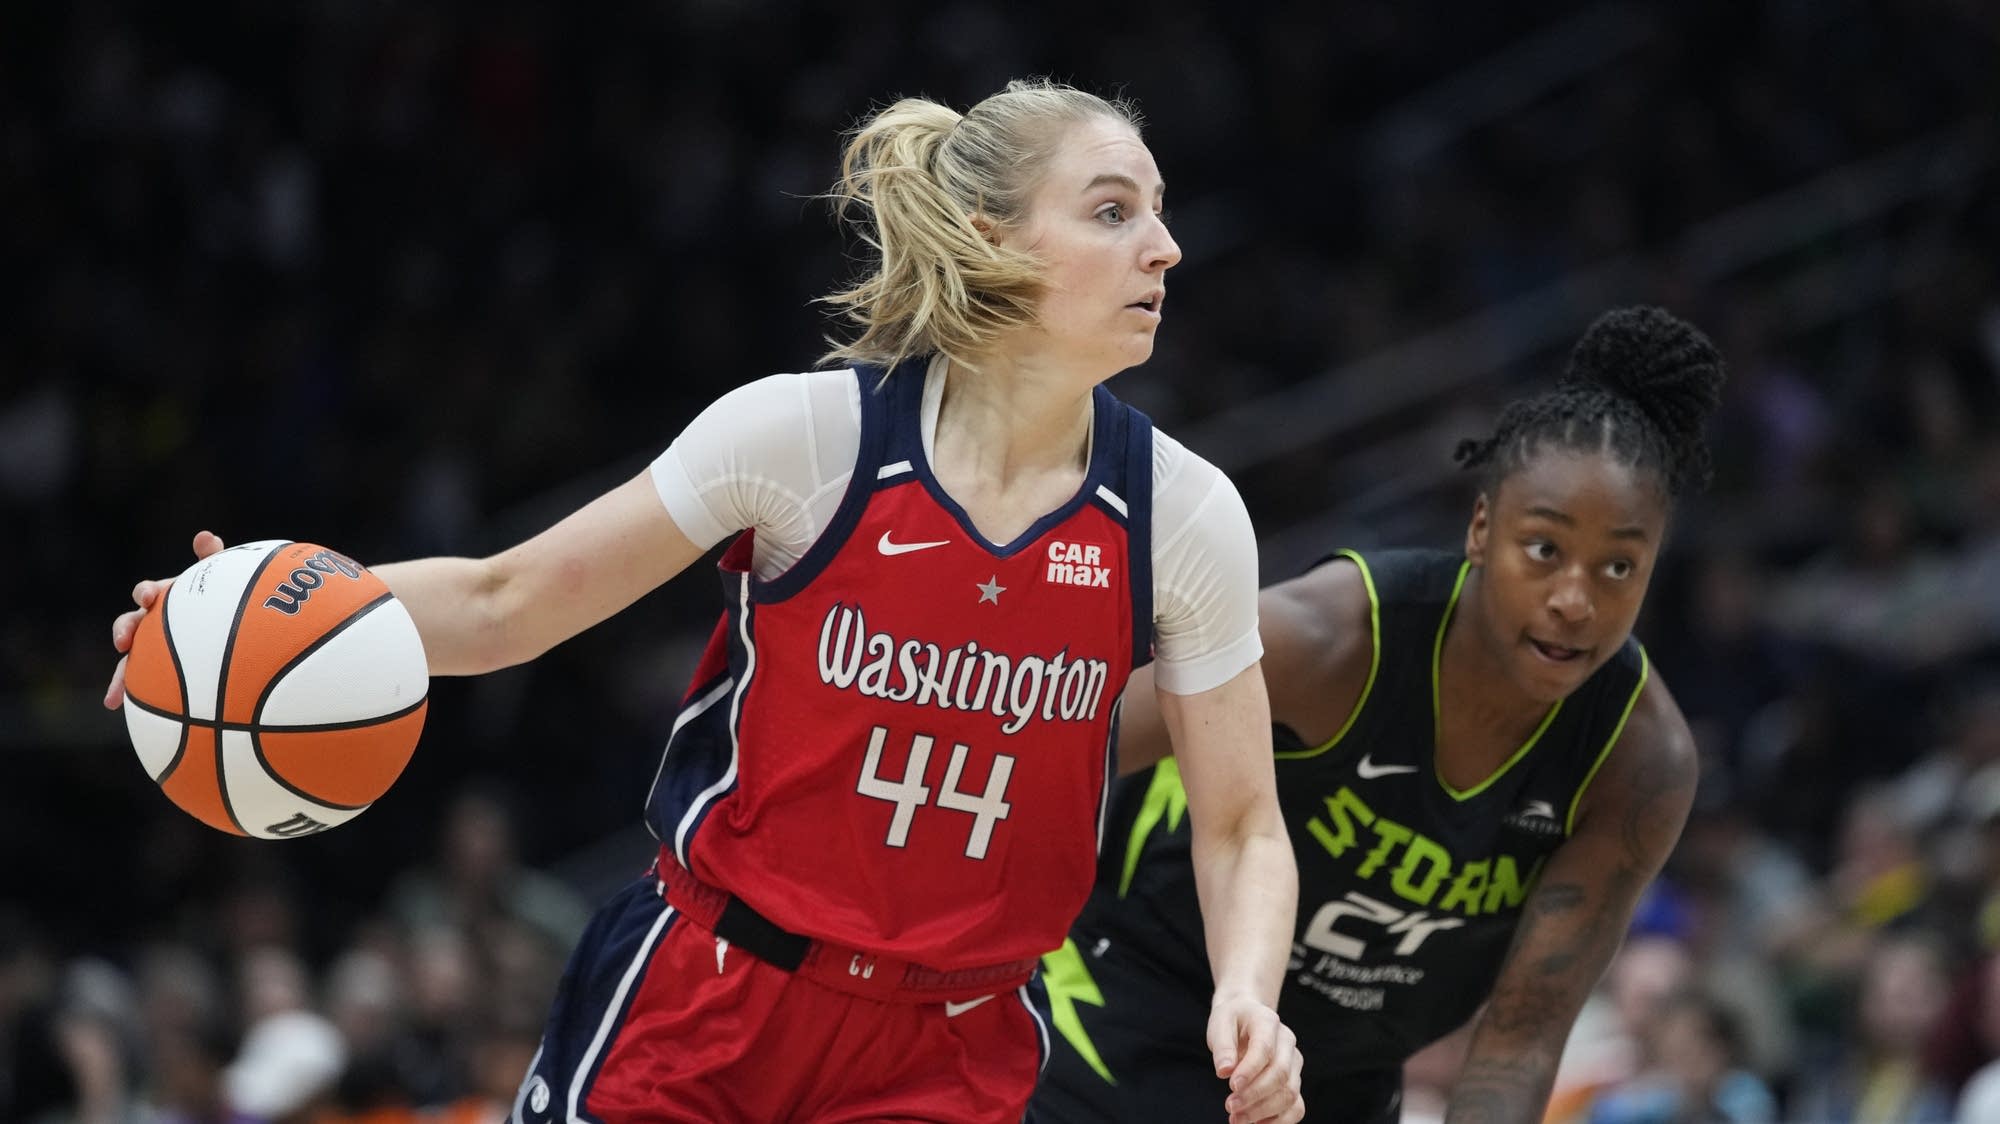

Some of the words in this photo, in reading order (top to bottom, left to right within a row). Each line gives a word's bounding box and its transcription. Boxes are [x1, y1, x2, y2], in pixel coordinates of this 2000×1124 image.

[1046, 562, 1112, 588] max
[1048, 541, 1102, 566] CAR
[263, 549, 362, 616] lson
[856, 725, 1016, 860] 44
